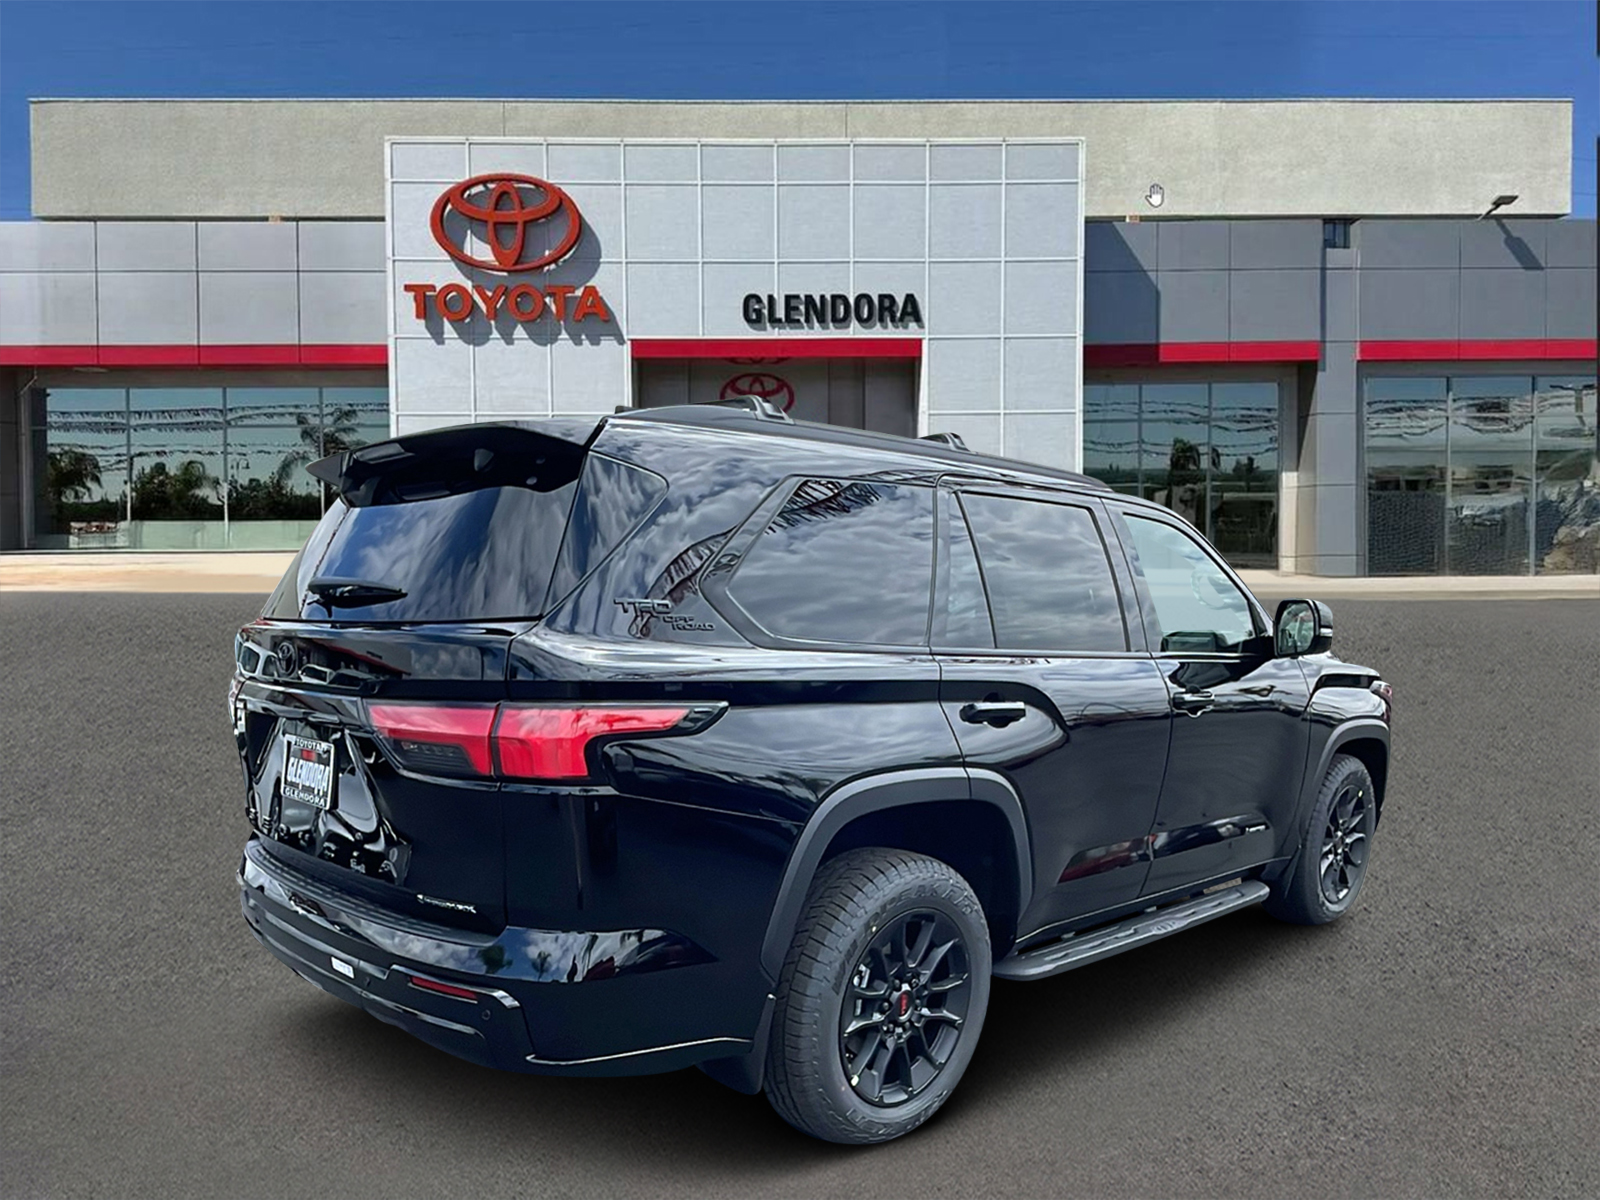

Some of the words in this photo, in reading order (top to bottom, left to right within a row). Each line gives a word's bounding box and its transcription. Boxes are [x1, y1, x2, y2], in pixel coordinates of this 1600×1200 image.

[403, 283, 610, 323] TOYOTA
[742, 292, 923, 325] GLENDORA
[671, 622, 716, 632] ROAD
[295, 738, 323, 751] TOYOTA
[286, 757, 330, 797] GLENDORA
[284, 786, 326, 807] GLENDORA
